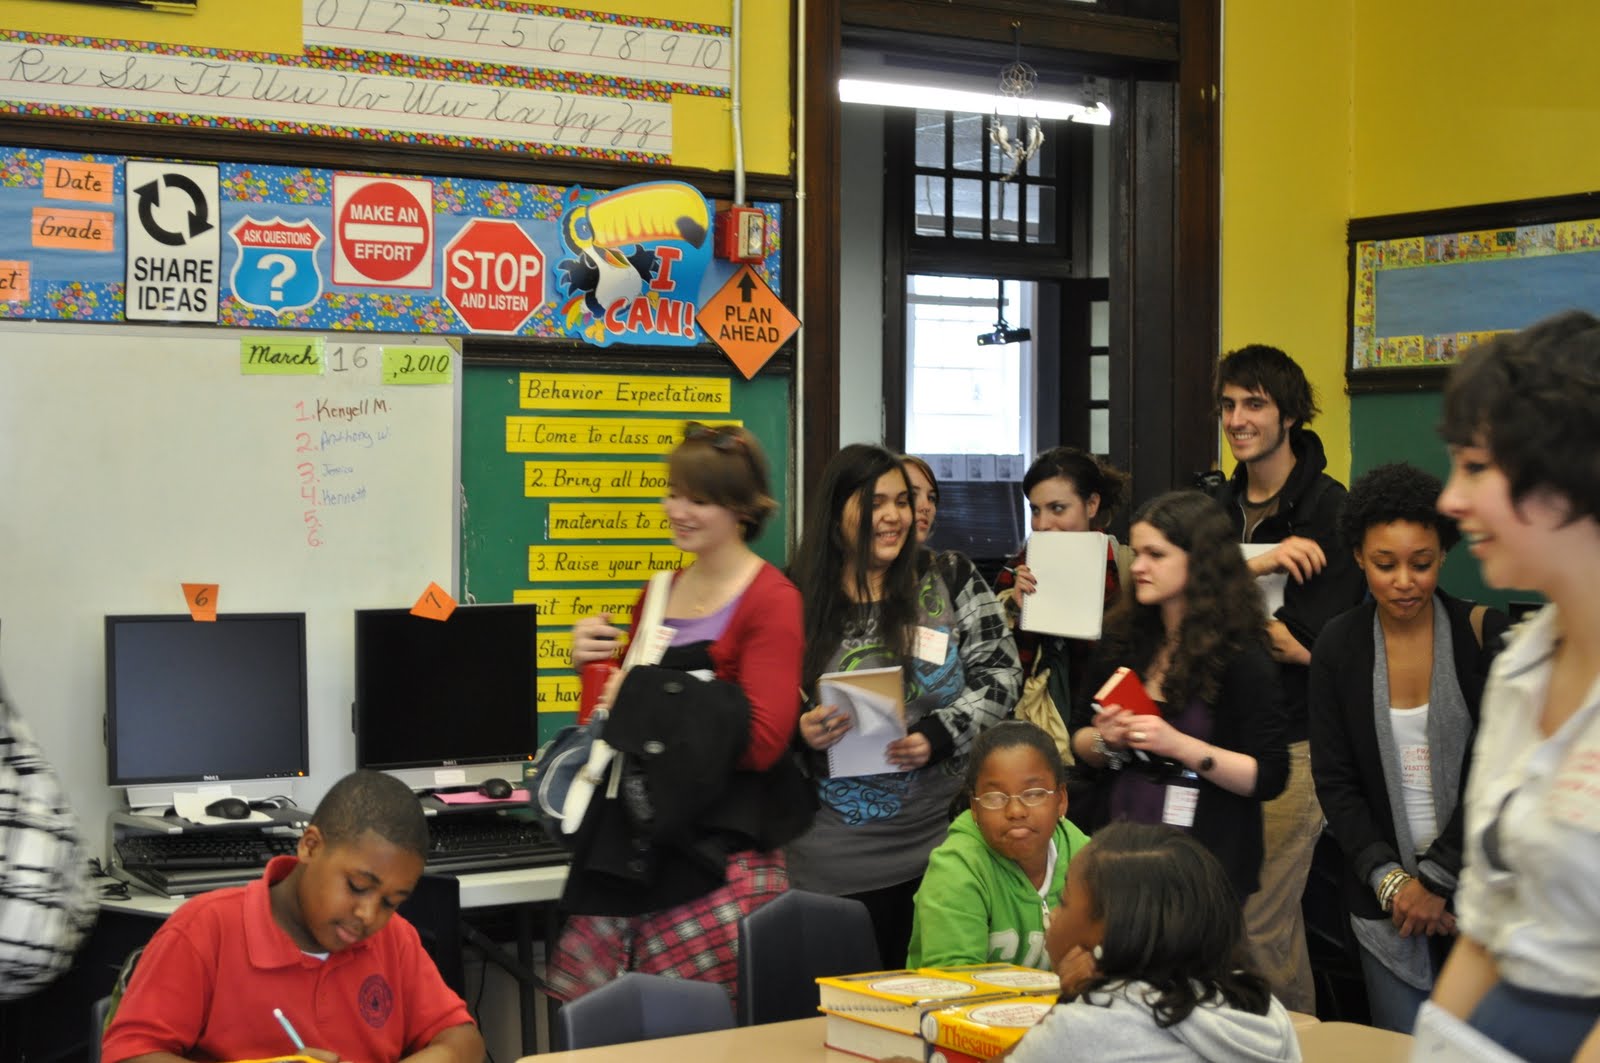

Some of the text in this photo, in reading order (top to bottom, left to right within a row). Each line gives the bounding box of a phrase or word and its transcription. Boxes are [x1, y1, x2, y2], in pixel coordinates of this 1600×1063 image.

[314, 0, 722, 69] 0 1 2 3 4 5 6 7 8 9 10
[55, 167, 103, 192] Date
[350, 204, 419, 223] MAKE AN
[40, 215, 103, 241] Grade
[243, 229, 312, 246] ASK QUESTIONS
[354, 243, 414, 262] EFFORT
[134, 256, 214, 285] SHARE
[450, 249, 541, 293] STOP
[650, 246, 684, 292] I
[138, 286, 208, 313] IDEAS
[460, 292, 529, 312] AND LISTEN
[603, 296, 696, 339] CAN!
[725, 305, 772, 325] PLAN
[719, 323, 780, 344] AHEAD
[248, 344, 319, 366] March
[332, 346, 369, 372] 16
[527, 379, 723, 406] Behavior Expectations
[295, 431, 319, 454] 2.
[517, 423, 674, 445] 1. Come to class on
[296, 461, 320, 485] 3.
[531, 468, 672, 494] 2. Bring all boo
[301, 485, 322, 506] 4.
[303, 509, 323, 529] 5.
[554, 511, 628, 530] materials
[635, 511, 651, 529] to
[307, 528, 324, 547] 6.
[536, 552, 684, 578] 3. Raise your hand
[536, 598, 560, 616] ait
[569, 596, 593, 615] for
[554, 683, 582, 703] hav
[941, 1023, 1004, 1058] Thesaur
